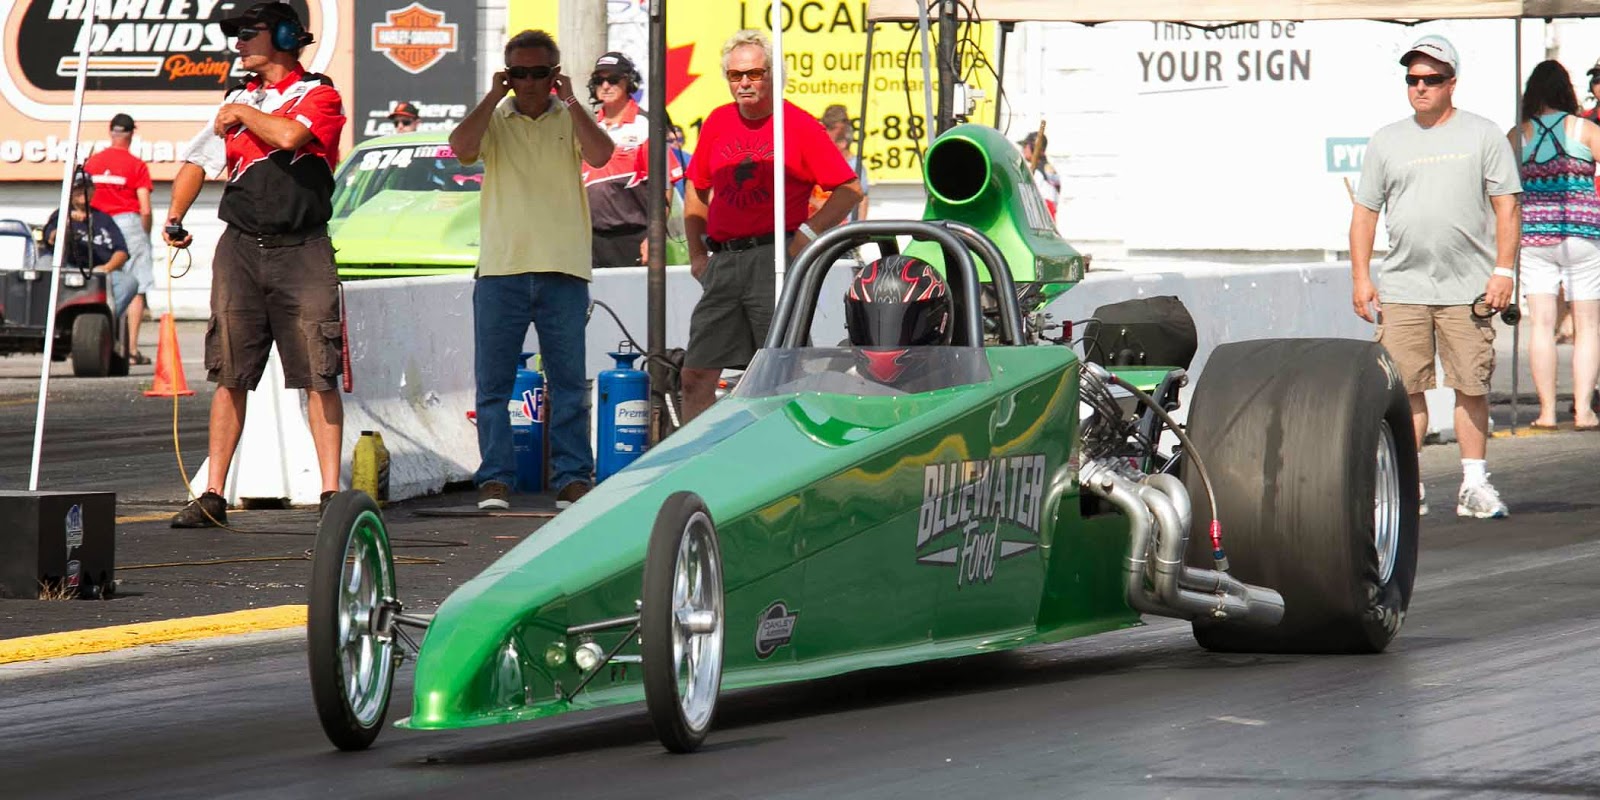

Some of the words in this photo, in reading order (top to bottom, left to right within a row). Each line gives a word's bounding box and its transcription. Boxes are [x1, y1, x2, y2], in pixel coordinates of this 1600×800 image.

[164, 54, 231, 83] Racing
[823, 52, 862, 71] our
[1137, 51, 1223, 82] YOUR
[1237, 49, 1311, 81] SIGN
[360, 148, 415, 172] 874
[916, 455, 1046, 549] BLUEWATER
[957, 513, 1001, 590] Ford
